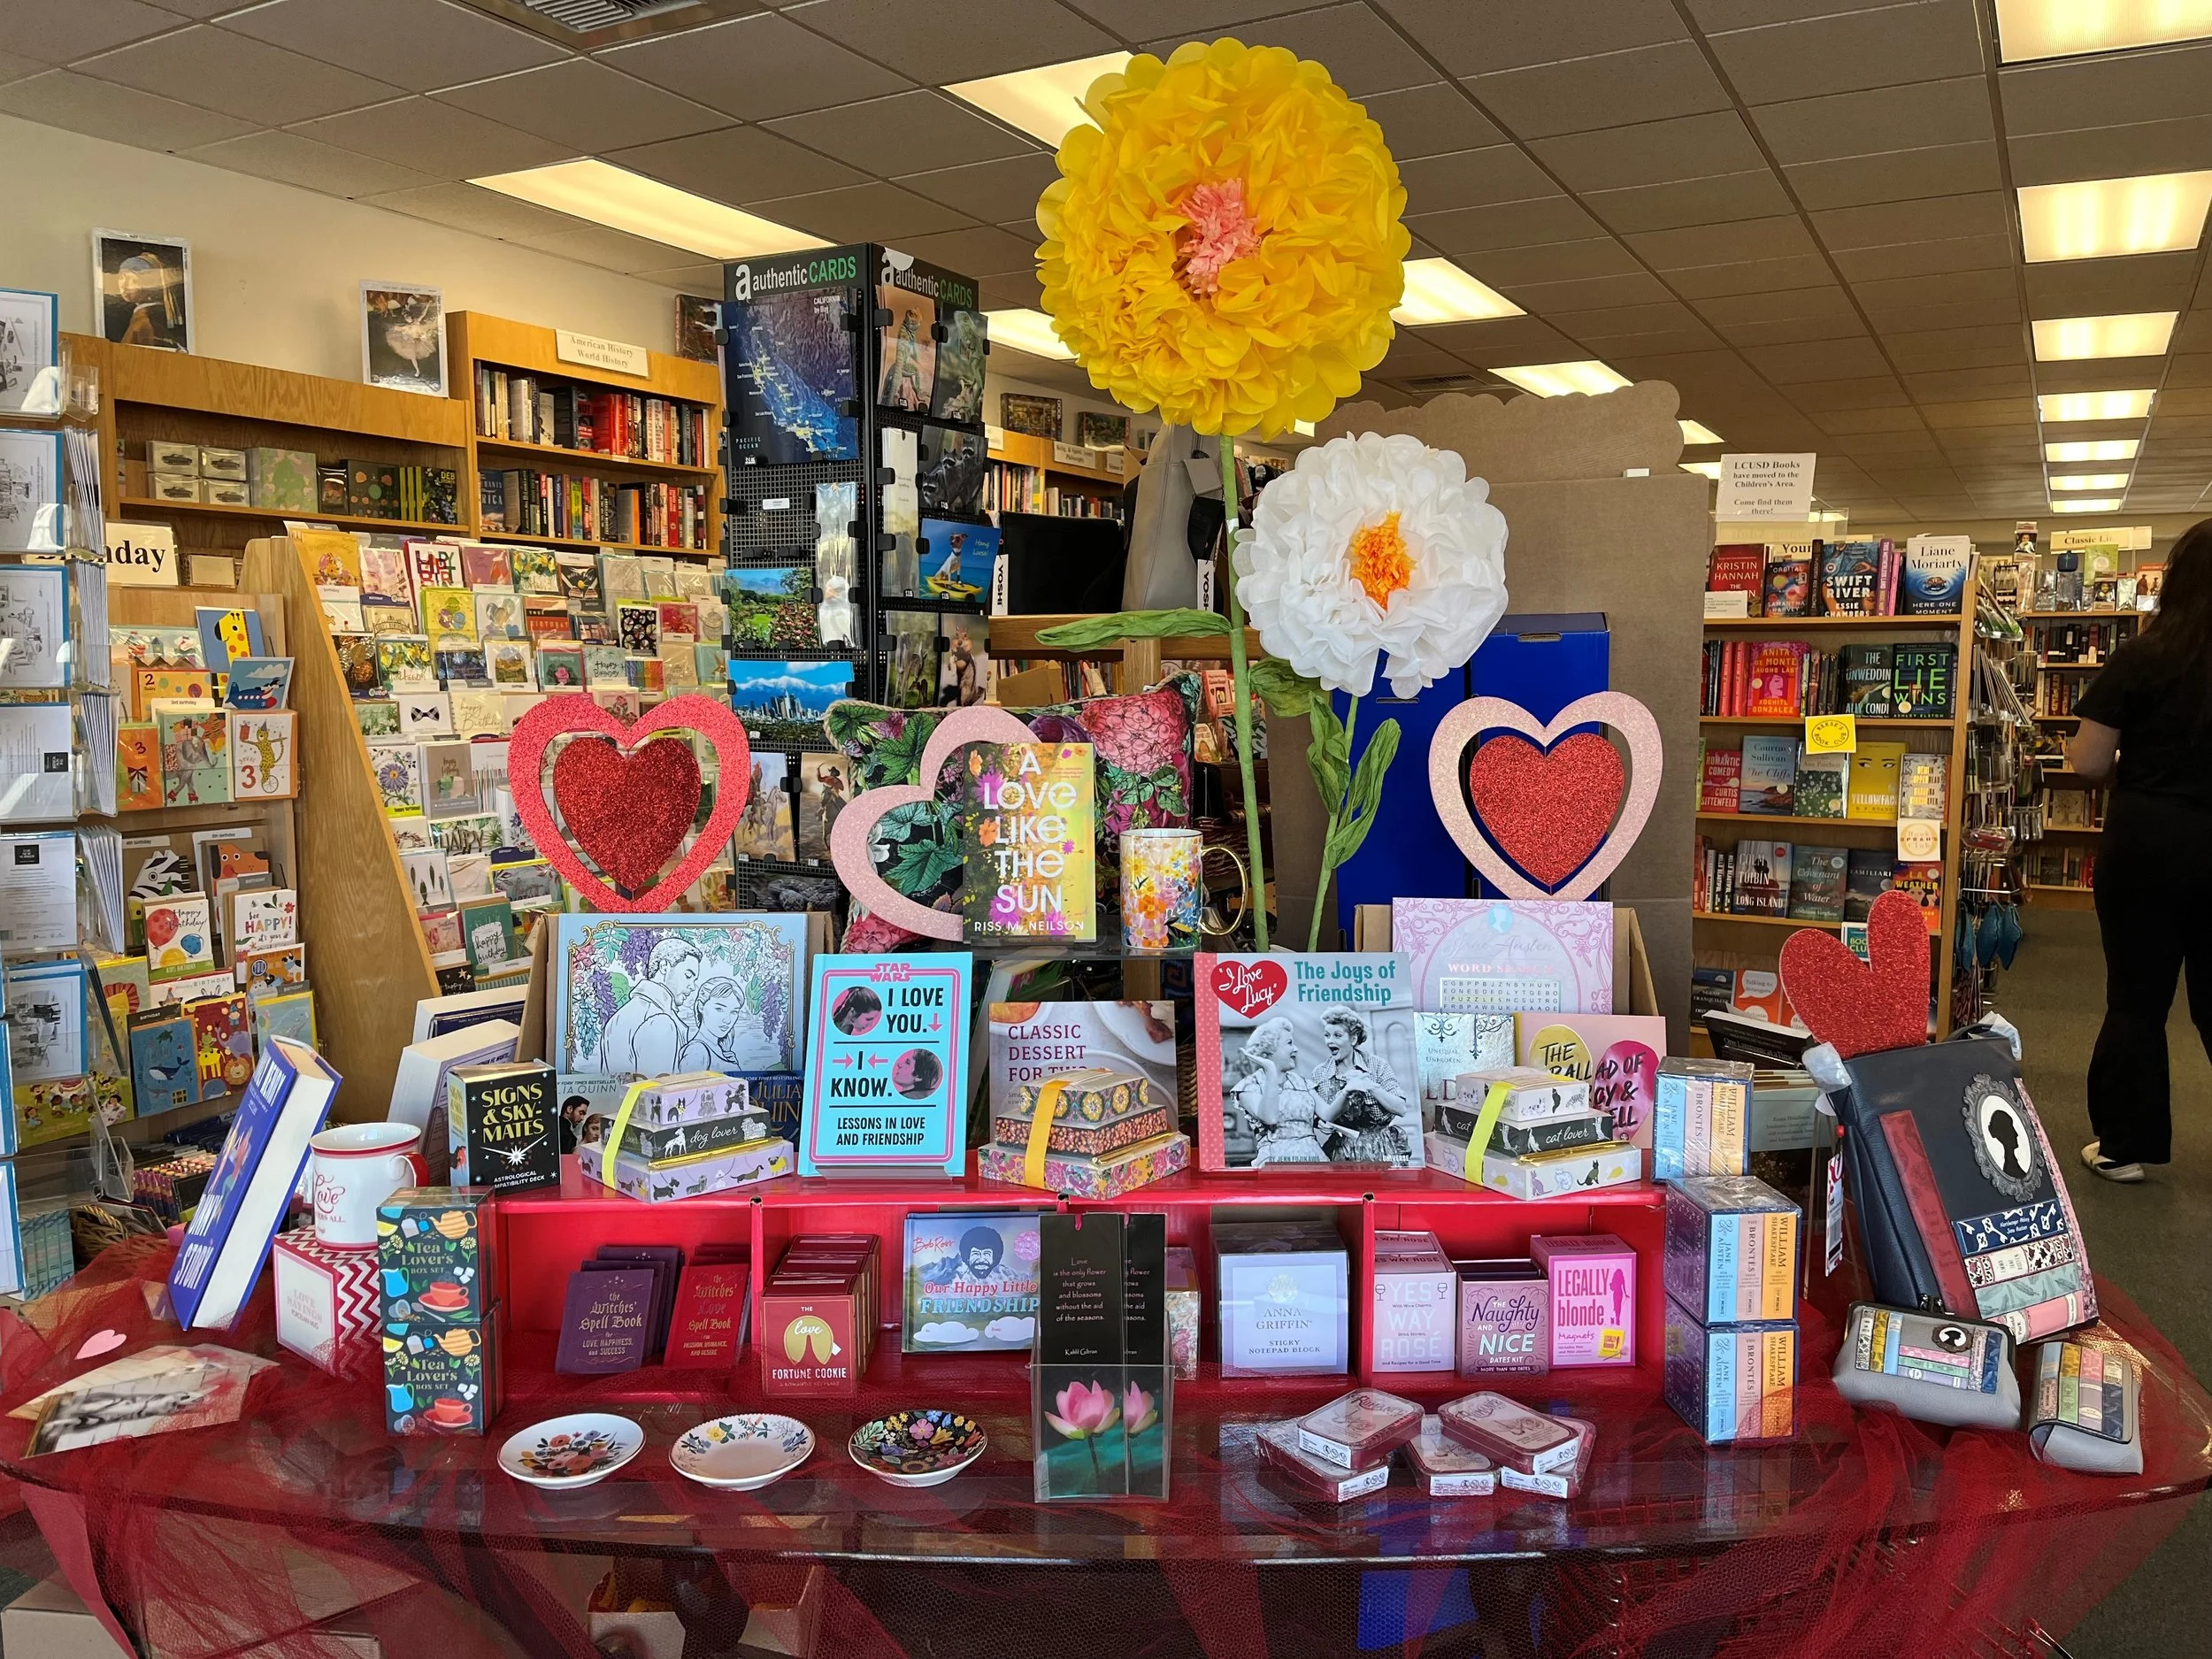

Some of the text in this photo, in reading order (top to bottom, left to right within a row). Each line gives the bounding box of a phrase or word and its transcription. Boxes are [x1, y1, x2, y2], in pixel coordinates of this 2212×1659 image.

[570, 336, 634, 358] American History
[577, 349, 629, 369] World History
[974, 539, 990, 549] Hang
[2064, 535, 2096, 544] Classic
[1921, 546, 1955, 557] Liane
[1717, 562, 1757, 571] KRISTIN
[1911, 559, 1963, 571] Moriarty
[1826, 575, 1872, 587] SWIFT
[1827, 588, 1870, 598] RIVER
[1865, 652, 1880, 664] THE
[1896, 654, 1948, 665] FIRST
[144, 673, 154, 685] 2
[1894, 669, 1946, 689] LIE
[1893, 693, 1946, 704] WINS
[1816, 722, 1844, 731] REESE'S
[1815, 733, 1847, 745] BOOK CLUB
[1018, 750, 1041, 775] A
[1706, 756, 1740, 767] ROMANTIC
[1708, 764, 1735, 777] COMEDY
[1715, 787, 1738, 798] CURTIS
[1701, 796, 1737, 808] SITTENFELD
[1812, 856, 1829, 866] The
[1797, 868, 1839, 879] Covenant
[1896, 880, 1938, 890] WEATHER
[996, 885, 1062, 913] SUN
[1736, 895, 1784, 909] LONG ISLAND
[173, 908, 201, 920] Happy
[245, 916, 292, 934] HAPPY!
[974, 920, 1084, 932] RISS M. NEILSON
[474, 931, 503, 949] happy
[478, 946, 506, 964] birthday
[874, 963, 911, 972] STAR
[1294, 961, 1395, 985] The Joys of
[869, 972, 911, 982] WARS
[887, 987, 943, 1007] I LOVE
[1241, 985, 1274, 1014] Lucy
[1298, 983, 1392, 1006] Friendship
[887, 1014, 927, 1033] YOU.
[1008, 1025, 1081, 1040] CLASSIC
[1008, 1045, 1087, 1060] DESSERT
[857, 1051, 864, 1070] I
[1009, 1067, 1041, 1082] FOR
[756, 1083, 802, 1100] JULIA
[831, 1078, 893, 1097] KNOW.
[481, 1082, 542, 1108] SIGNS
[483, 1102, 542, 1125] & SKY-
[837, 1117, 926, 1130] LESSONS IN LOVE
[483, 1118, 544, 1144] MATES
[690, 1126, 737, 1148] dog lover
[1546, 1126, 1589, 1143] cat lover
[836, 1133, 925, 1145] AND FRIENDSHIP
[494, 1171, 537, 1183] ASTROLOGICAL
[412, 1242, 441, 1254] Tea
[1778, 1217, 1787, 1267] WILLIAM
[402, 1253, 454, 1265] Lover's
[1071, 1257, 1088, 1266] Love
[1071, 1270, 1086, 1279] only
[924, 1282, 1037, 1295] Our Happy Little
[1558, 1268, 1609, 1297] LEGALLY
[1390, 1280, 1432, 1302] YES
[590, 1302, 637, 1314] Witches'
[920, 1297, 1040, 1314] FRIENDSHIP
[1056, 1314, 1064, 1323] of
[1471, 1295, 1540, 1333] Naughty
[1557, 1299, 1604, 1326] blonde
[579, 1314, 642, 1333] Spell Book
[1388, 1310, 1434, 1330] WAY
[795, 1319, 823, 1335] love
[1558, 1331, 1594, 1341] Magnets
[1479, 1333, 1535, 1356] NICE
[772, 1368, 847, 1379] FORTUNE COOKIE
